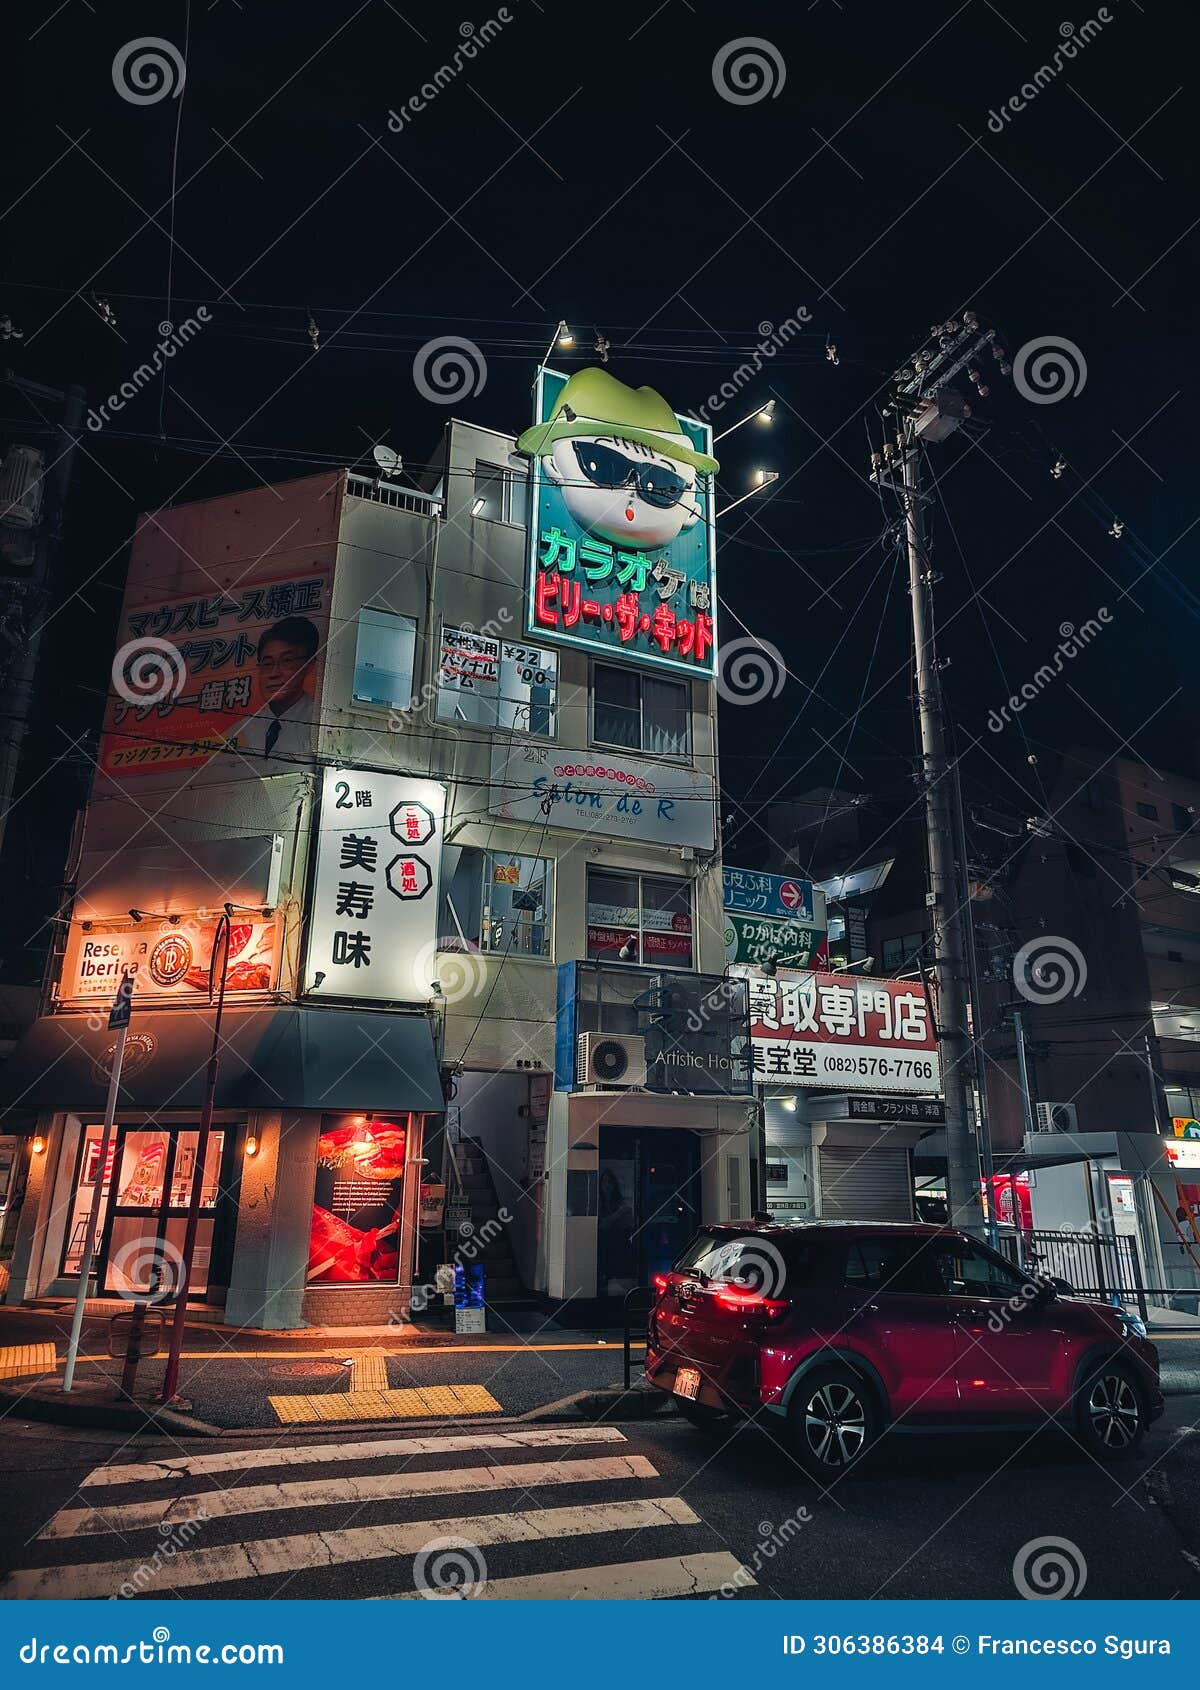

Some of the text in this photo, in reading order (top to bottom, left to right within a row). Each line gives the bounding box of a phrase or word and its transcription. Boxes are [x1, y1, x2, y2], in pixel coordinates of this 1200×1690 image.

[540, 527, 710, 609] カラオケは
[127, 579, 323, 638] マウスピース矯正
[537, 572, 714, 660] ビリー・ザ・キッド
[122, 633, 256, 685] プラント
[335, 782, 372, 808] 2階
[617, 792, 642, 815] de
[658, 800, 674, 821] R
[405, 808, 420, 839] ご飯処
[400, 862, 418, 892] 酒処
[332, 833, 378, 968] 美寿味
[84, 942, 147, 958] Resea
[81, 959, 139, 976] Iberica
[750, 977, 927, 1041] 買取専門店
[655, 1049, 703, 1068] Artistic
